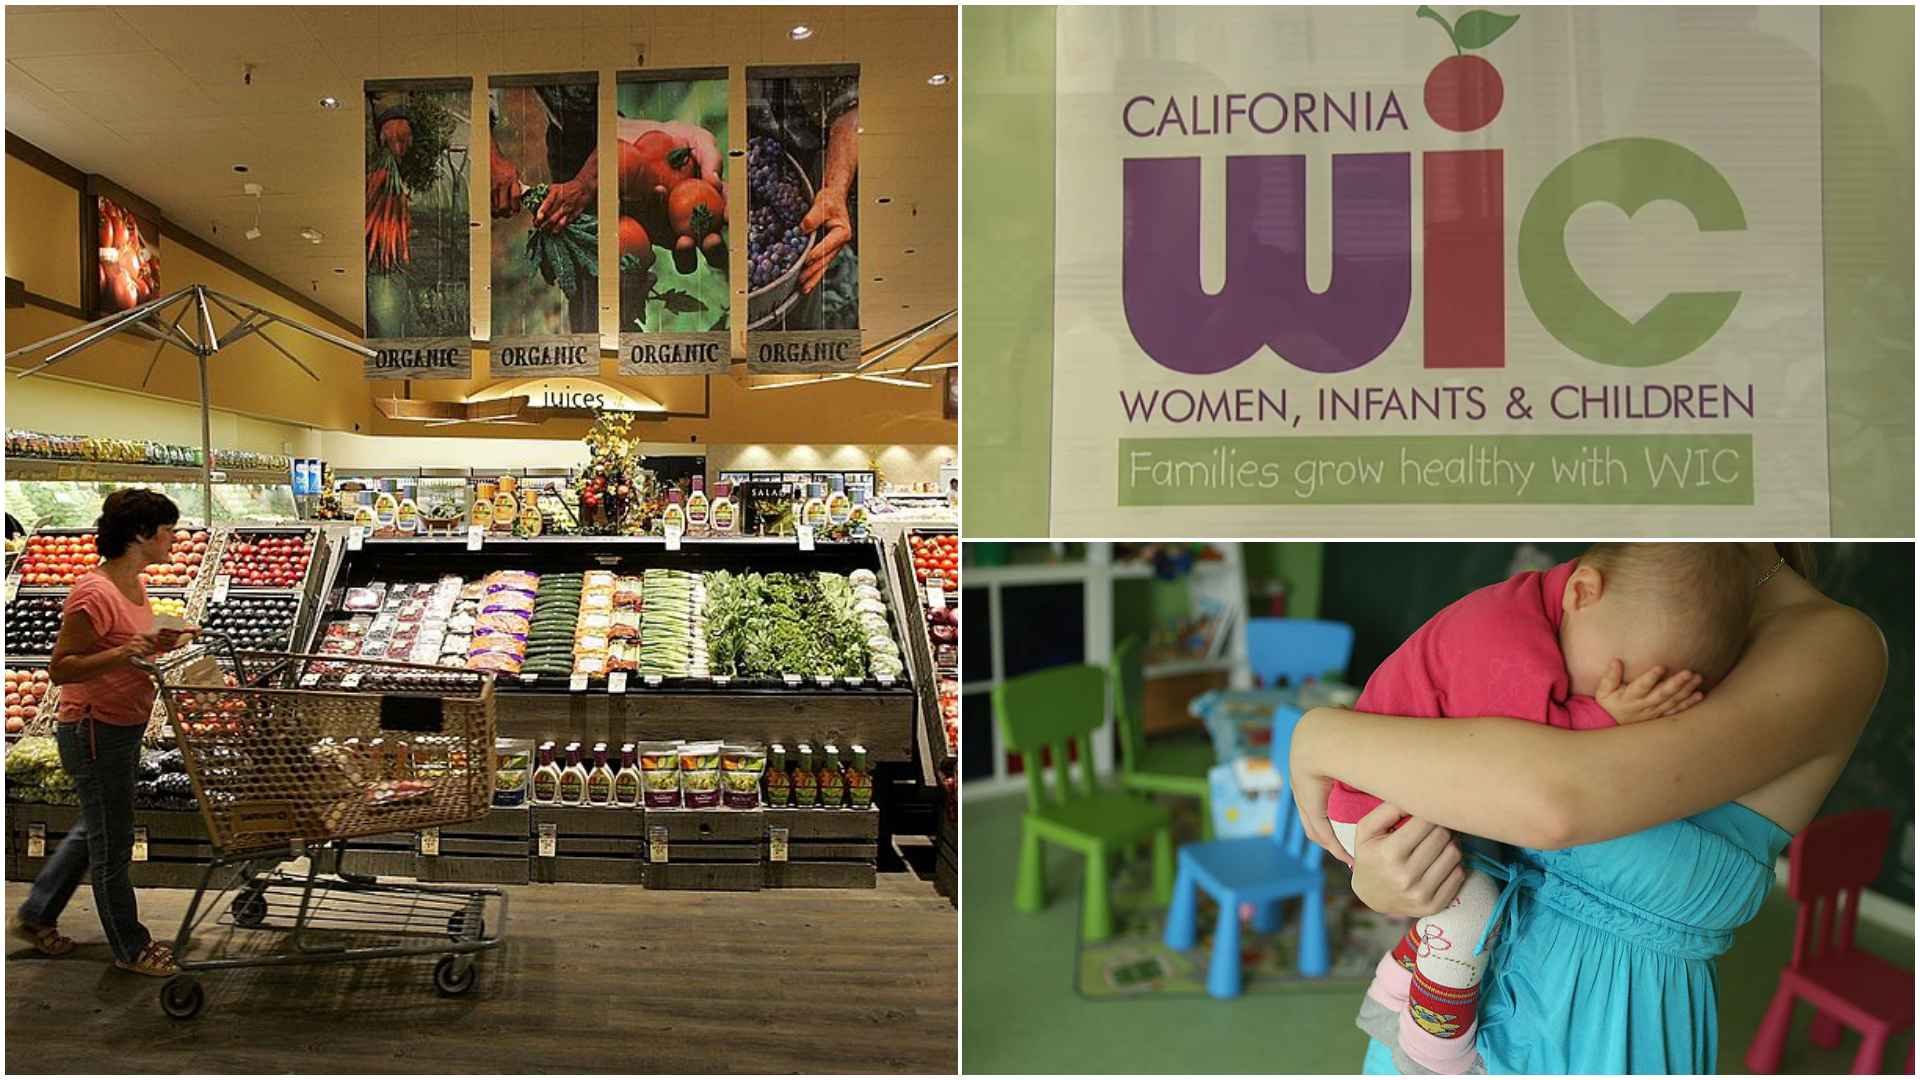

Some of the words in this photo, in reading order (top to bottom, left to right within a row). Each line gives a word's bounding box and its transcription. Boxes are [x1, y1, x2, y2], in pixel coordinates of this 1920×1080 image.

[1122, 90, 1409, 138] CALIFORNIA
[375, 349, 459, 368] ORGANIC
[501, 345, 588, 366] ORGANIC
[631, 343, 719, 364] ORGANIC
[759, 341, 849, 363] ORGANIC
[543, 385, 605, 409] juices
[1119, 388, 1301, 428] WOMEN,
[1319, 386, 1487, 421] INFANTS
[1505, 386, 1533, 420] &
[1550, 384, 1754, 420] CHILDREN
[1130, 446, 1279, 488] Families
[1294, 456, 1384, 498] grow
[1401, 444, 1535, 496] healthy
[1551, 446, 1627, 487] with
[1644, 447, 1739, 488] WIC
